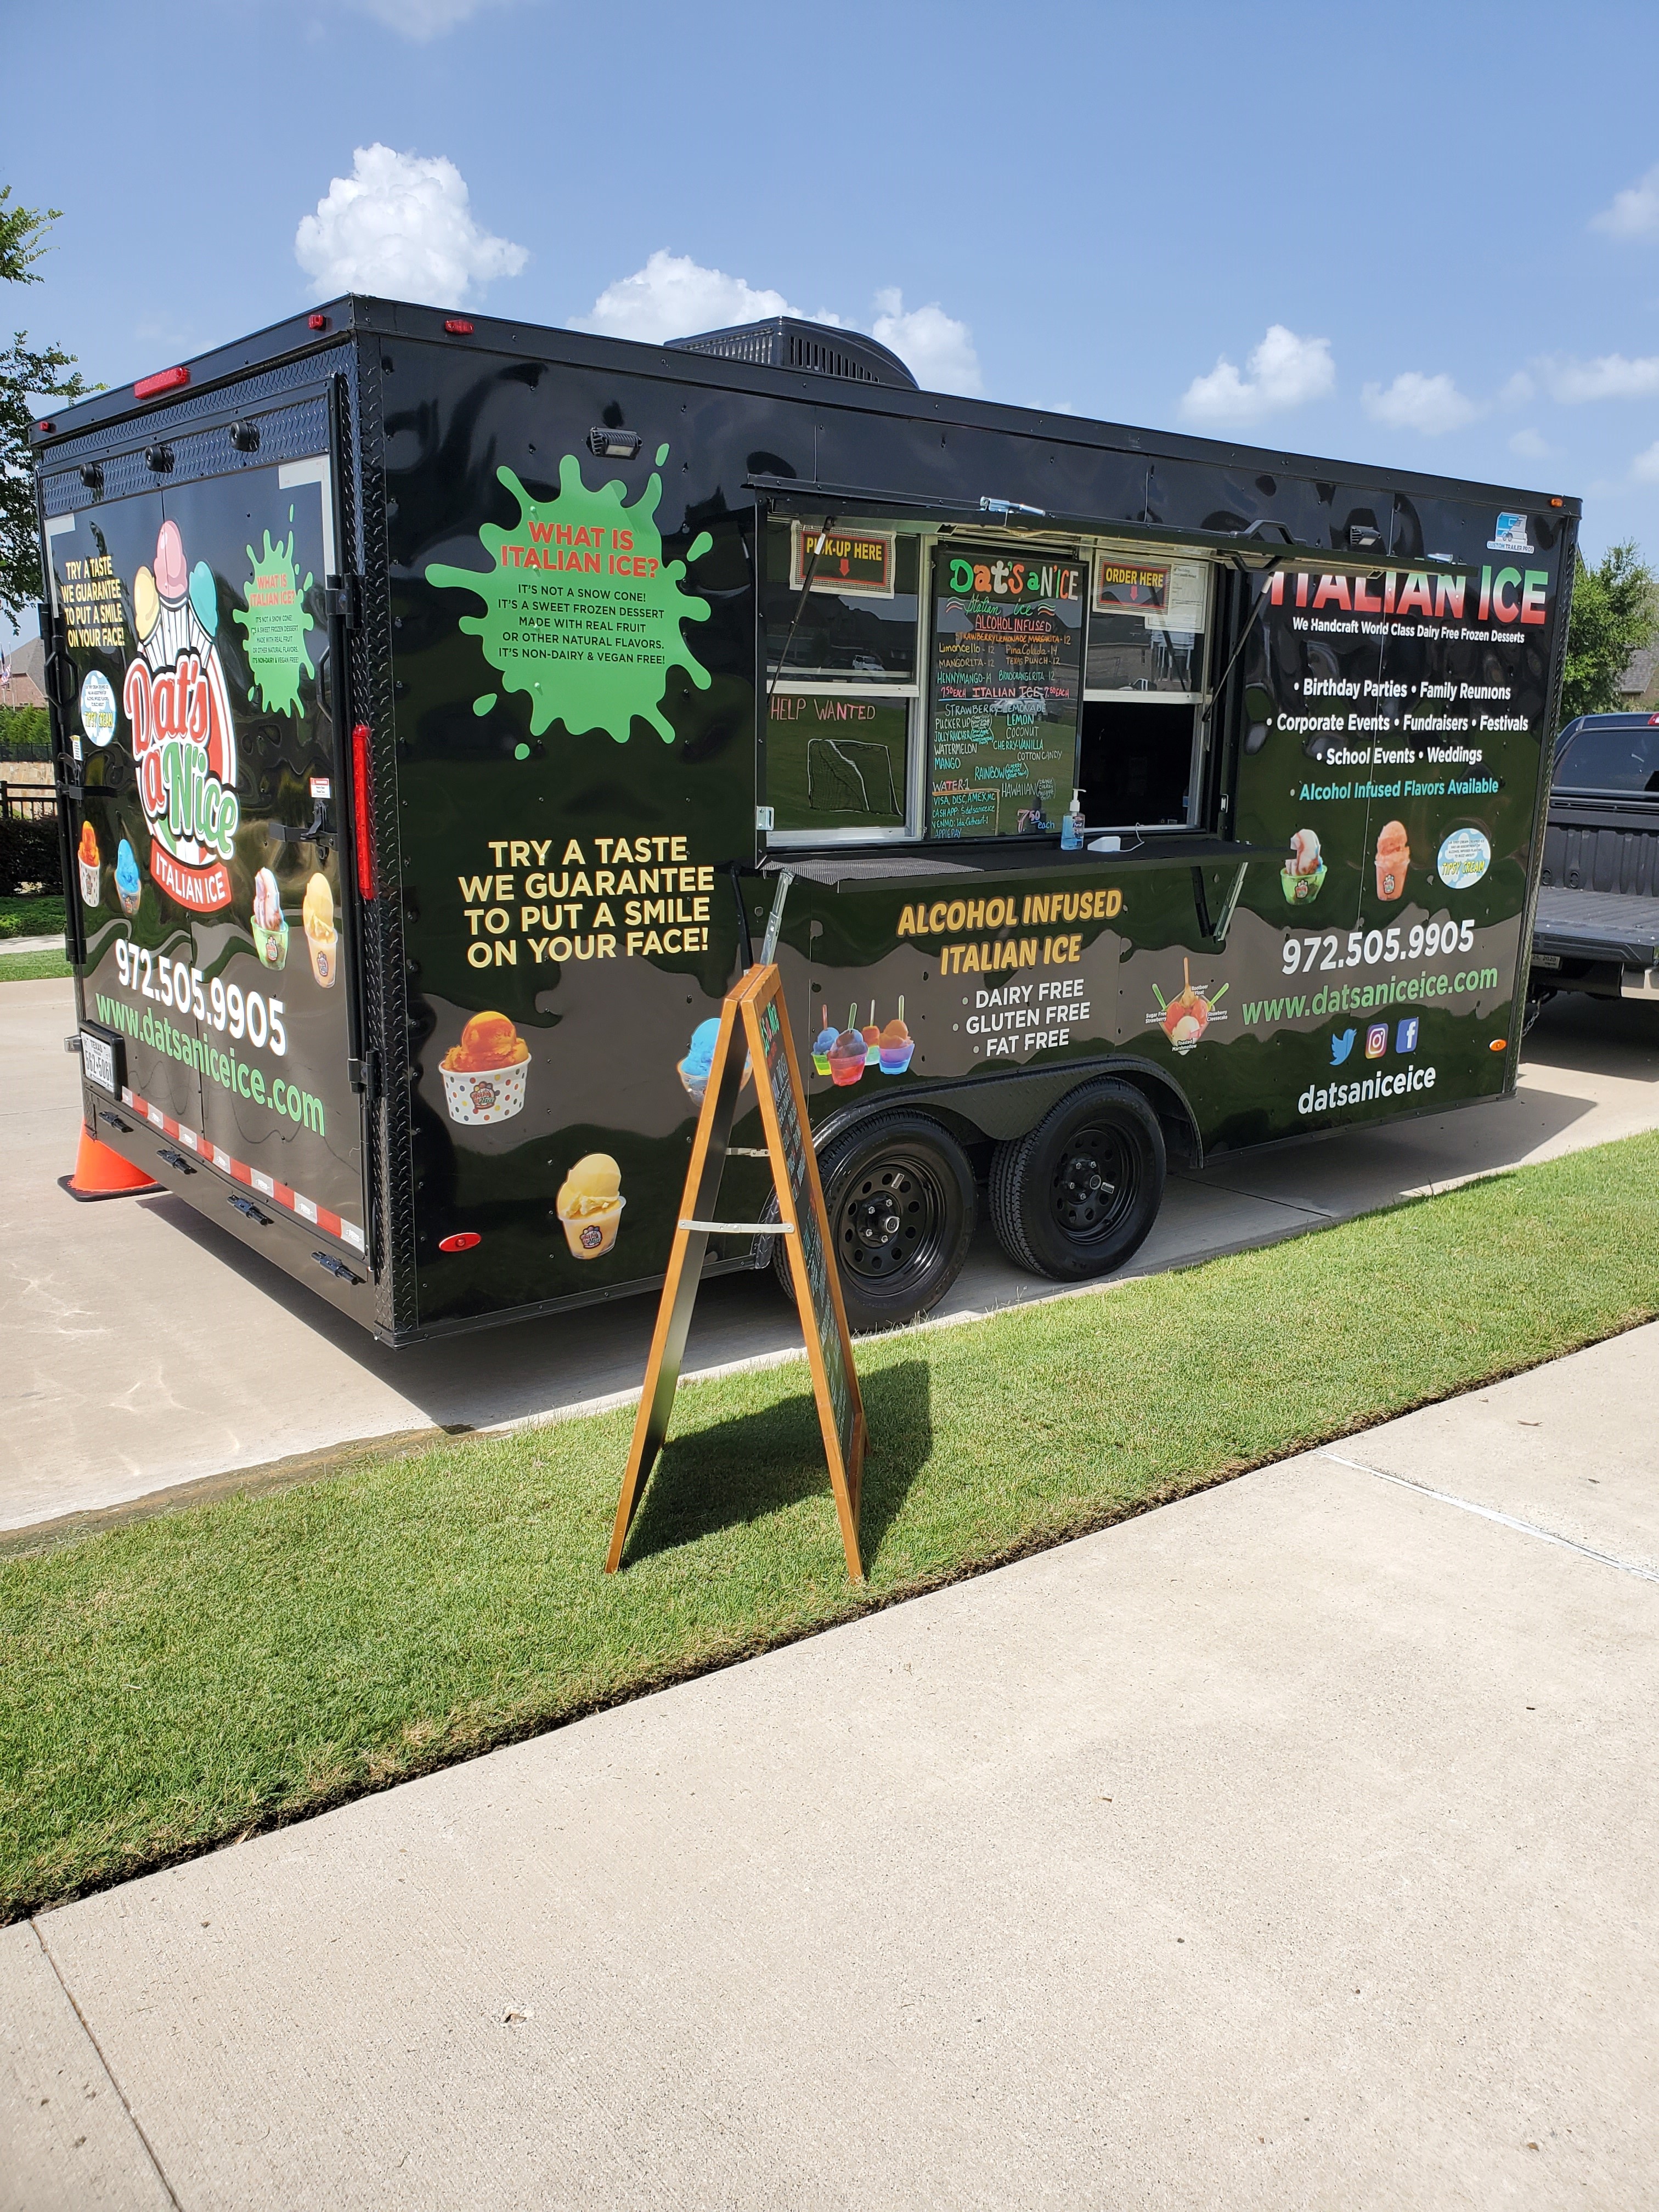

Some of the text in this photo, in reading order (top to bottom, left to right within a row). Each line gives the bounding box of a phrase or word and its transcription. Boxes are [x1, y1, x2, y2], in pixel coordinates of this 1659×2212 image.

[528, 521, 634, 551] WHAT IS
[806, 537, 882, 561] PIK-UP HERE
[66, 556, 113, 580] TRY A TASTE
[501, 545, 659, 578] ITALIAN ICE?
[257, 573, 287, 589] WHAT IS
[1106, 568, 1137, 585] ORDER
[1139, 572, 1164, 588] HERE
[61, 579, 121, 603] WE GUARANTEE
[250, 590, 295, 607] ITALIAN ICE?
[518, 584, 646, 602] IT'S NOT A SNOW CONE!
[1477, 566, 1549, 625] ICE
[64, 603, 123, 625] TO PUT A SMILE
[498, 599, 664, 619] IT'S A SWEET FROZEN DESSERT
[519, 617, 646, 633] MADE WITH REAL FRUIT
[975, 614, 1052, 632] ALCOHOL INFUSED
[1293, 617, 1525, 644] We Handcraft World Class Dairy Free Frozen Desserts
[68, 627, 125, 647] ON YOUR FACE!
[503, 632, 664, 649] OR OTHER NATURAL FLAVORS.
[498, 647, 665, 664] IT'S NON-DAIRY & VEGAN FREE!
[972, 686, 1040, 698] ITALIAN ICE
[1303, 679, 1511, 701] Birthday Parties Family Reunions
[124, 658, 208, 757] Dat's
[771, 696, 876, 721] HELP WANTED
[85, 712, 113, 728] TIPSY CREAM
[935, 718, 961, 730] PUCKER
[1007, 713, 1034, 726] LEMON
[1277, 714, 1528, 734] Corporate Events Fundraisers Festivals
[1006, 726, 1040, 740] COCONUT
[934, 743, 978, 755] WATERMELON
[1326, 746, 1482, 765] School Events Weddings
[934, 757, 961, 770] MANGO
[144, 748, 166, 812] a
[1299, 777, 1499, 800] Alcohol Infused Flavors Available
[1038, 821, 1054, 830] each
[488, 836, 688, 868] TRY A TASTE
[156, 851, 226, 904] ITALIAN ICE
[1442, 860, 1485, 876] TIPSY CREAM
[459, 867, 715, 902] WE GUARANTEE
[464, 896, 710, 935] TO PUT A SMILE
[897, 889, 1122, 936] ALCOHOL INFUSED
[466, 927, 709, 969] ON YOUR FACE!
[940, 934, 1082, 975] ITALIAN ICE
[1282, 919, 1475, 975] 972.505.9905
[116, 938, 286, 1056] 972.505.9905
[975, 979, 1084, 1008] DAIRY FREE
[1242, 966, 1498, 1025] www.datsaniceice.com
[966, 1002, 1091, 1034] GLUTEN FREE
[90, 1040, 103, 1053] TEXAS
[986, 1029, 1070, 1057] FAT FREE
[95, 991, 326, 1137] www.datsaniceice.com
[1298, 1064, 1436, 1115] datsaniceice
